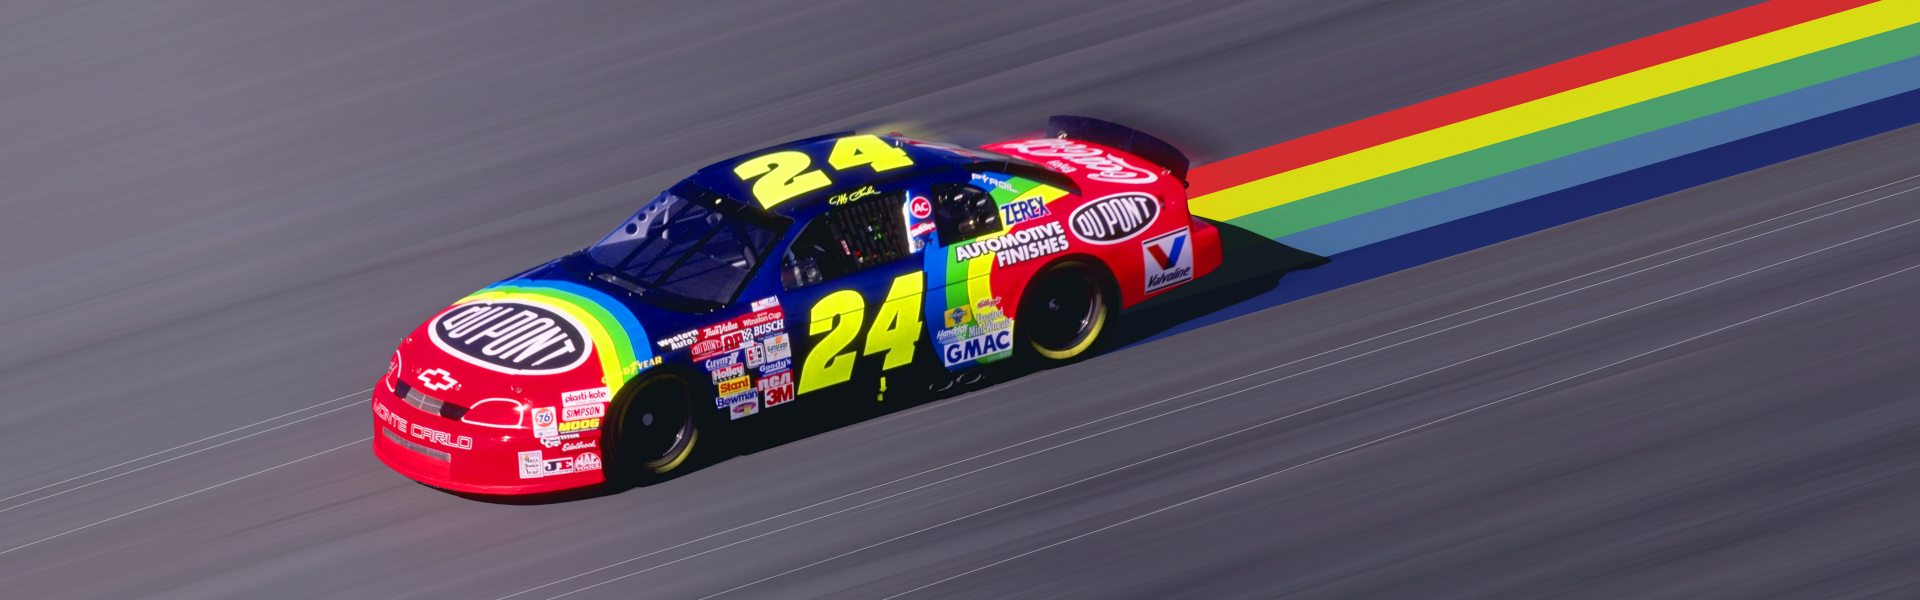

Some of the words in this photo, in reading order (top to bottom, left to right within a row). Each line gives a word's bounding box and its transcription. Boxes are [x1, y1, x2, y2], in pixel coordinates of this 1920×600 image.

[734, 134, 914, 210] 24
[972, 173, 1019, 194] PYROIL
[914, 202, 929, 214] AC
[1000, 196, 1050, 225] ZEREX
[956, 220, 1065, 262] AUTOMOTIVE
[997, 235, 1069, 268] FINISHES
[1147, 266, 1191, 288] Valvoline
[742, 315, 769, 327] Winston
[767, 312, 782, 321] Cup
[753, 319, 784, 337] BUSCH
[656, 328, 699, 348] Western
[797, 270, 923, 395] 24
[670, 338, 693, 351] Auto
[946, 330, 1011, 364] GMAC
[713, 365, 743, 381] Holley
[759, 358, 792, 373] Goody's
[720, 377, 749, 394] Stant
[758, 372, 792, 392] RCA
[564, 389, 607, 404] plasti-kote
[717, 390, 758, 408] Bowman
[766, 383, 794, 406] 3M
[538, 412, 551, 423] 76
[566, 406, 601, 419] SIMPSON
[373, 398, 408, 434] MONTE
[411, 423, 473, 450] CARLO
[558, 418, 600, 432] MOOG
[561, 440, 597, 452] Edelbrock
[544, 459, 574, 472] JE
[576, 453, 601, 467] MAC
